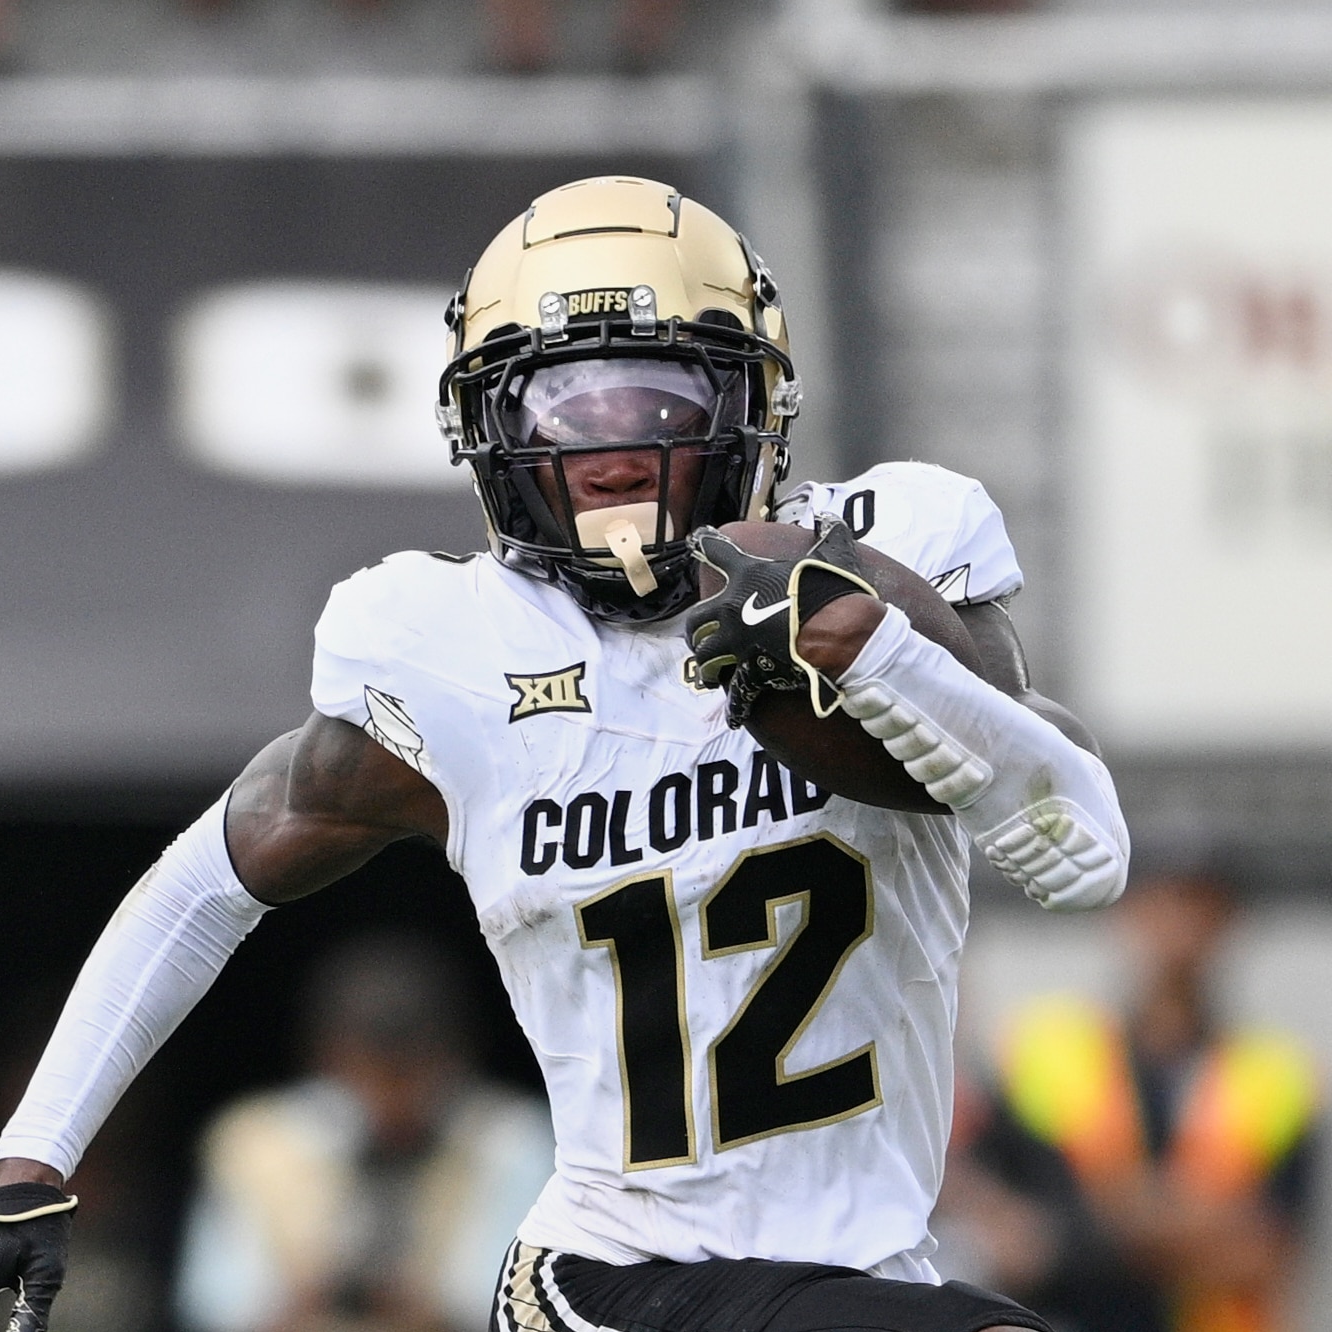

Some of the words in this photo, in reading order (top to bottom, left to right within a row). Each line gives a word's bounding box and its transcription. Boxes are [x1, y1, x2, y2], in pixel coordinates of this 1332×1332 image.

[568, 291, 629, 317] BUFFS
[505, 661, 592, 724] XII
[520, 750, 833, 876] COLORA
[574, 830, 883, 1173] 12
